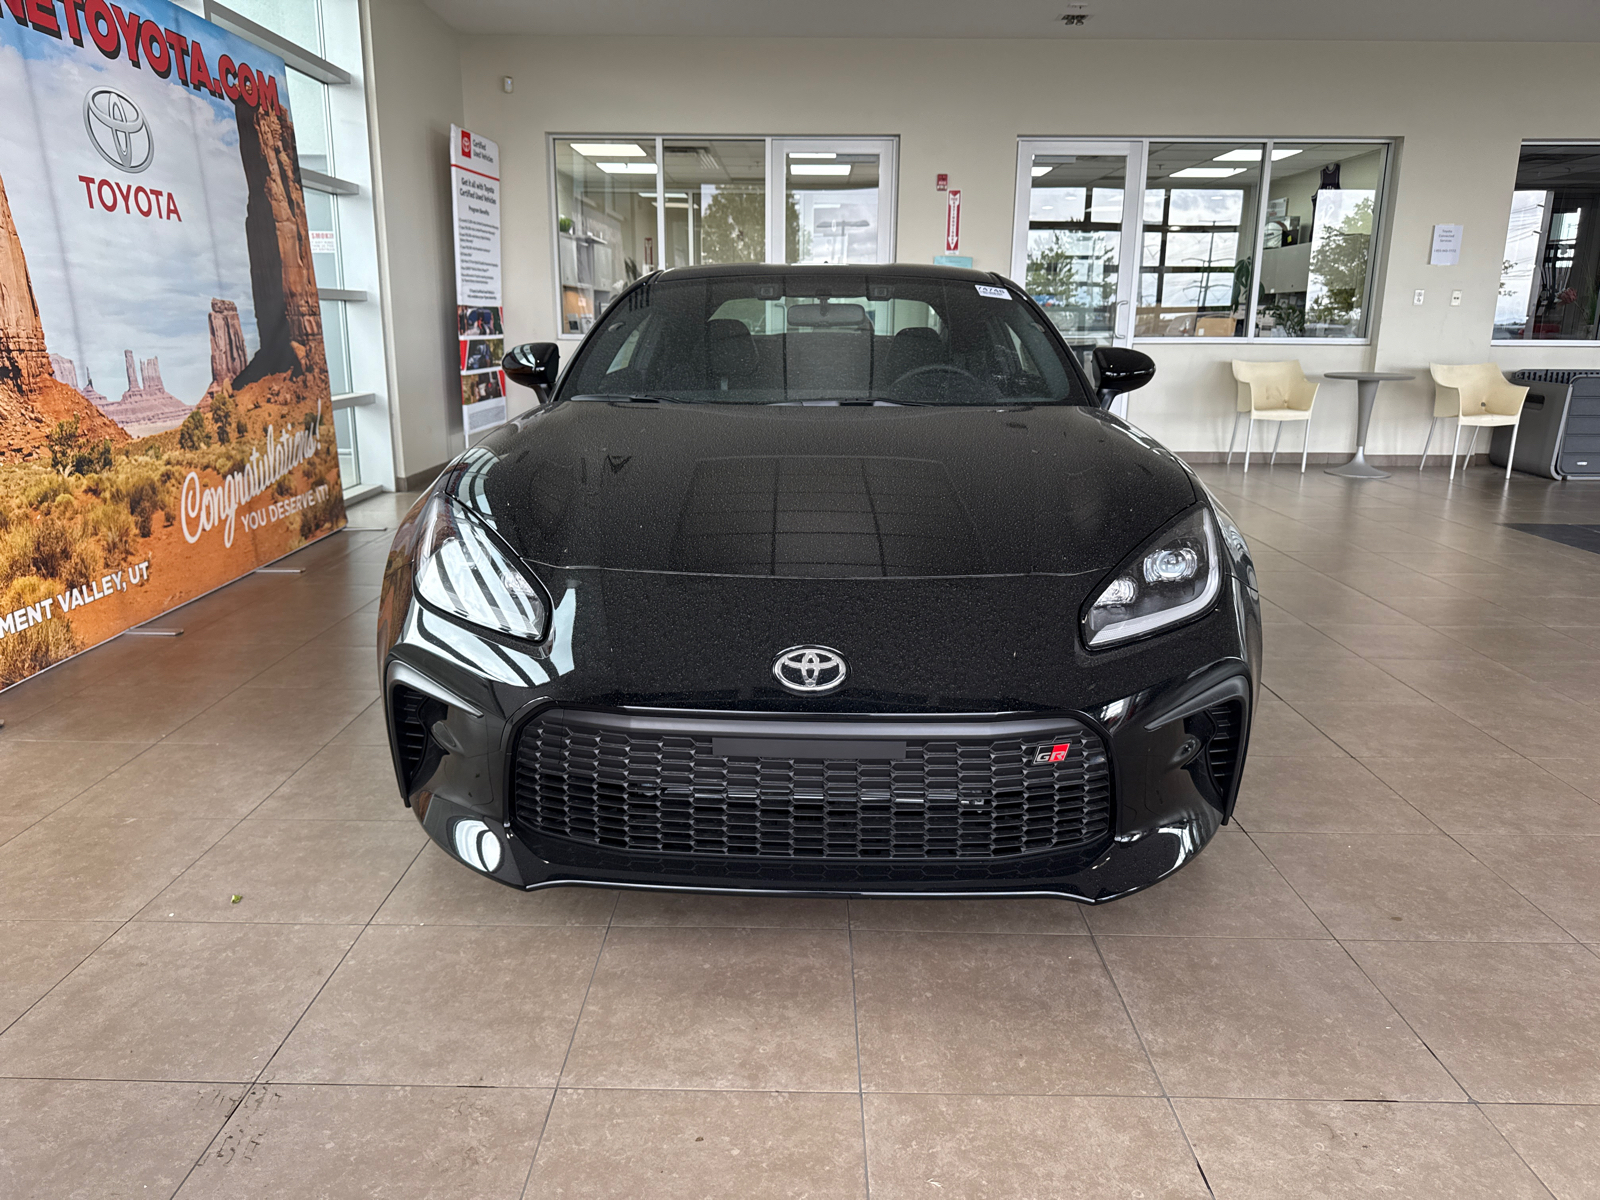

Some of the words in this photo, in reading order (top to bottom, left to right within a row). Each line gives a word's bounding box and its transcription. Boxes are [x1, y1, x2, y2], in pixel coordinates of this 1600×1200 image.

[78, 175, 182, 222] TOYOTA
[180, 398, 322, 549] Congratulations!
[241, 510, 267, 532] YOU
[269, 491, 317, 523] DESERVE
[315, 484, 329, 503] IT!
[57, 571, 127, 613] VALLEY,
[128, 561, 149, 585] UT
